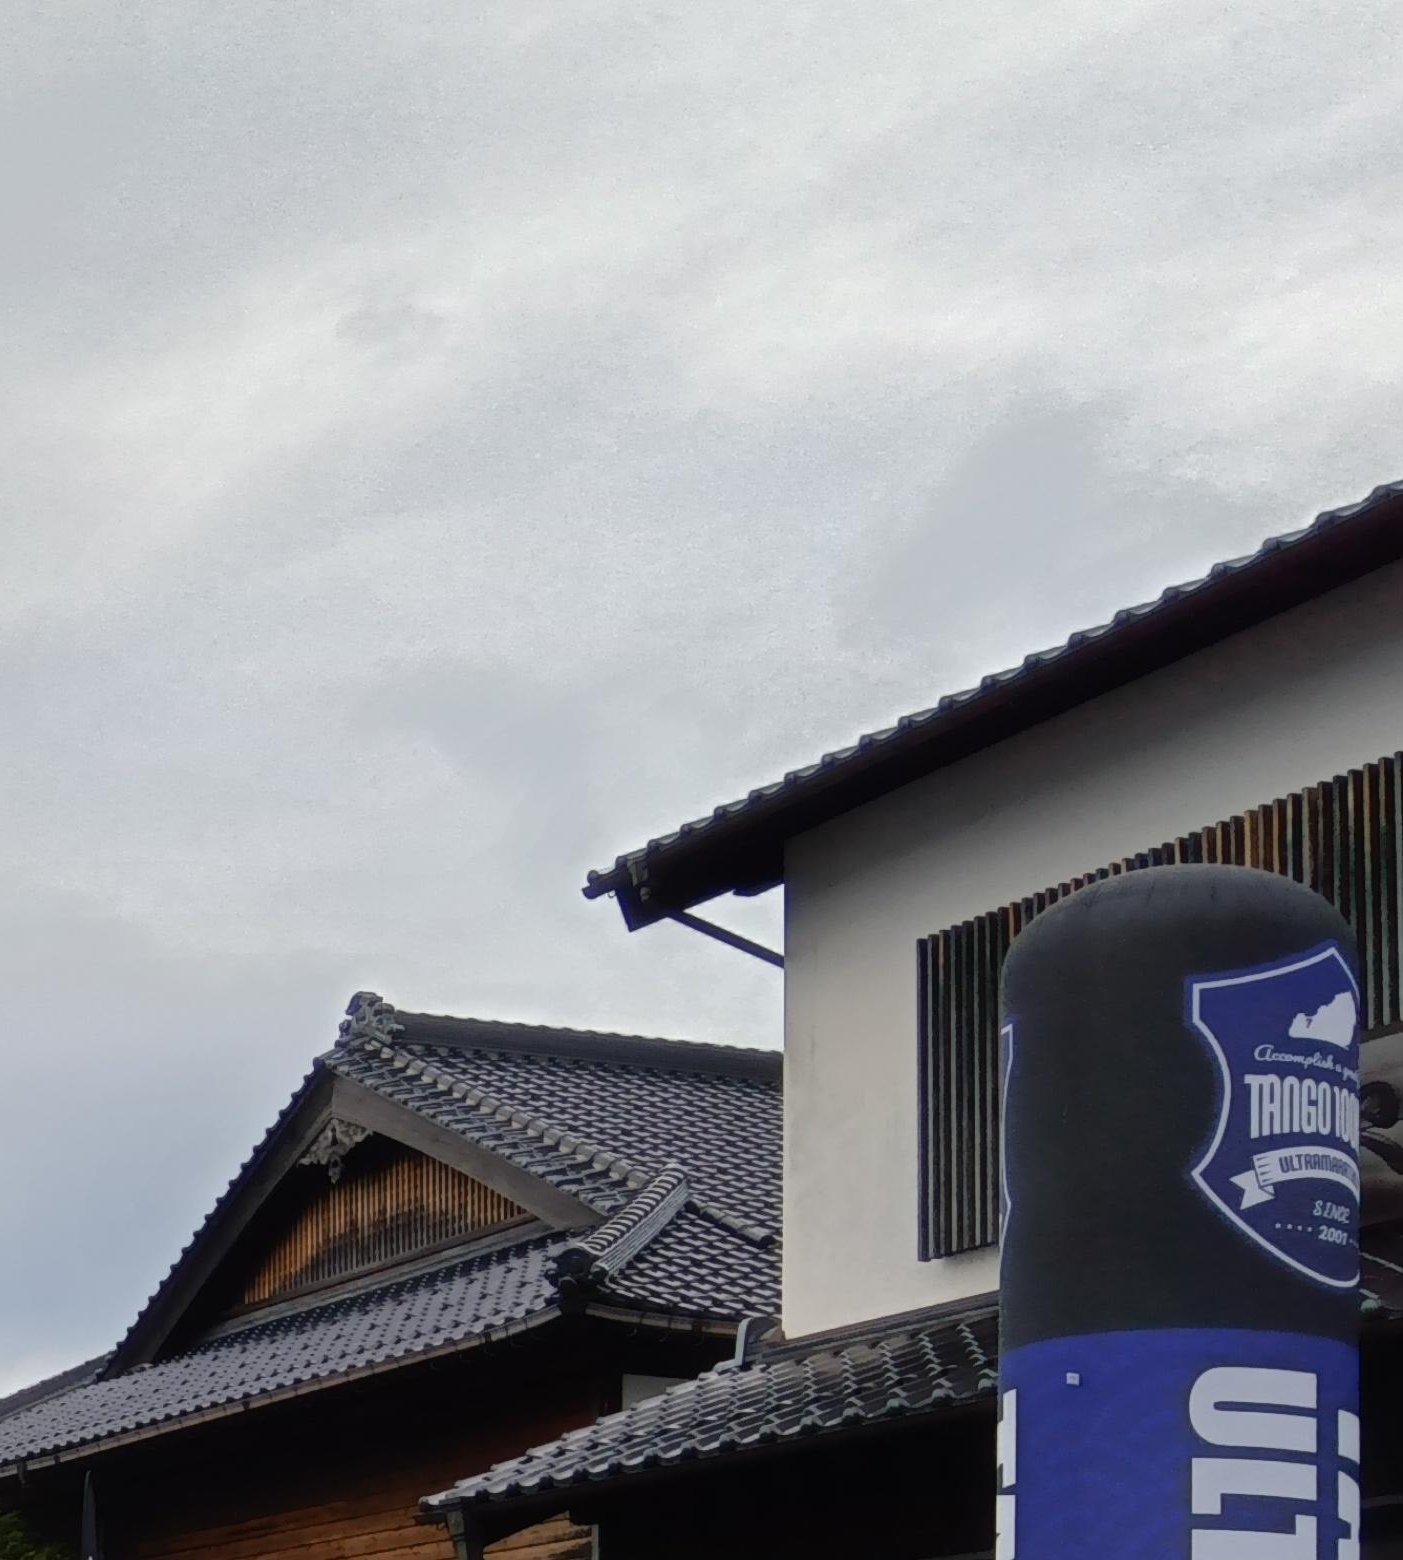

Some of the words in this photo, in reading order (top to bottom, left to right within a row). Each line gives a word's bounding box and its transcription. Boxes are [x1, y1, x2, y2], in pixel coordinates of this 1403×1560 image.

[1244, 1074, 1331, 1139] TANGO
[1313, 1200, 1350, 1224] SINCE
[1318, 1226, 1348, 1246] 2001
